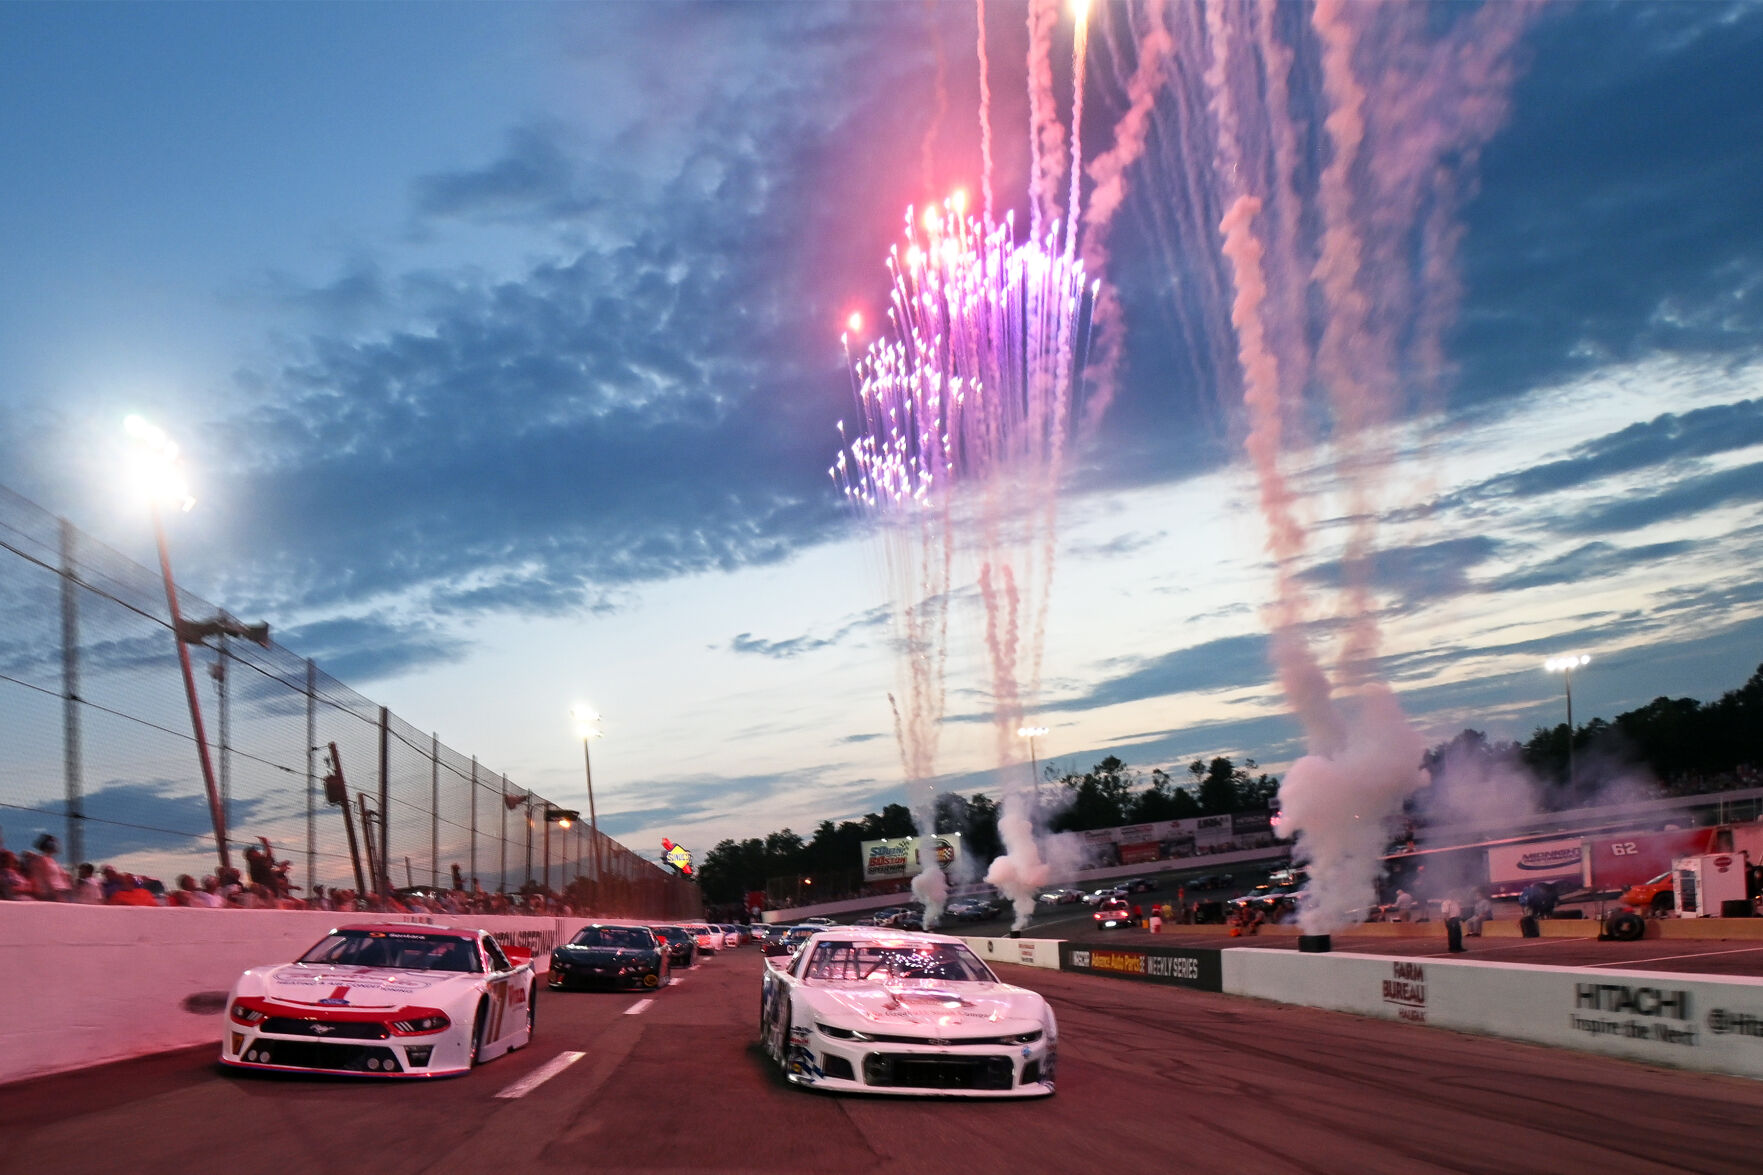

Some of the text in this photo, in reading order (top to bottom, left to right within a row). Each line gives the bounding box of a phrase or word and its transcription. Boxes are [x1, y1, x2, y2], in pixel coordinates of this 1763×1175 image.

[1611, 842, 1638, 856] 62
[1111, 953, 1124, 971] Auto
[1124, 954, 1140, 972] Parts
[1147, 956, 1173, 976] WEEKLY
[1173, 958, 1198, 979] SERIES
[1394, 961, 1424, 982] FARM
[1383, 979, 1426, 1003] BUREAU
[1575, 983, 1689, 1020] HITACHI
